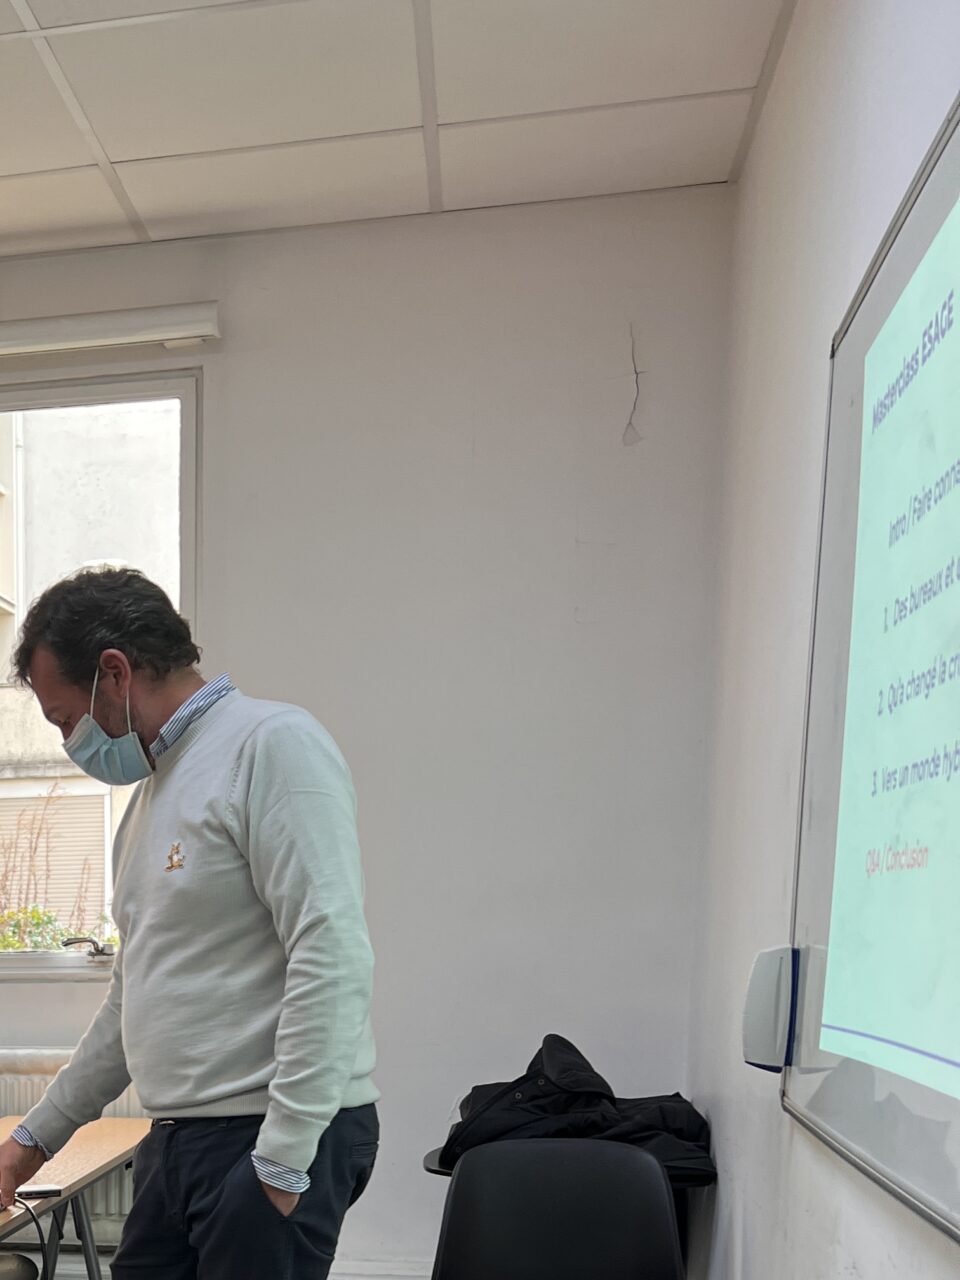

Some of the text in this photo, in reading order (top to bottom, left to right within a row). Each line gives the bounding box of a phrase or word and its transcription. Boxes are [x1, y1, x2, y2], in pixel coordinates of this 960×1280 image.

[921, 288, 954, 367] ESAGE
[909, 568, 944, 615] bureaux
[910, 747, 941, 784] monde
